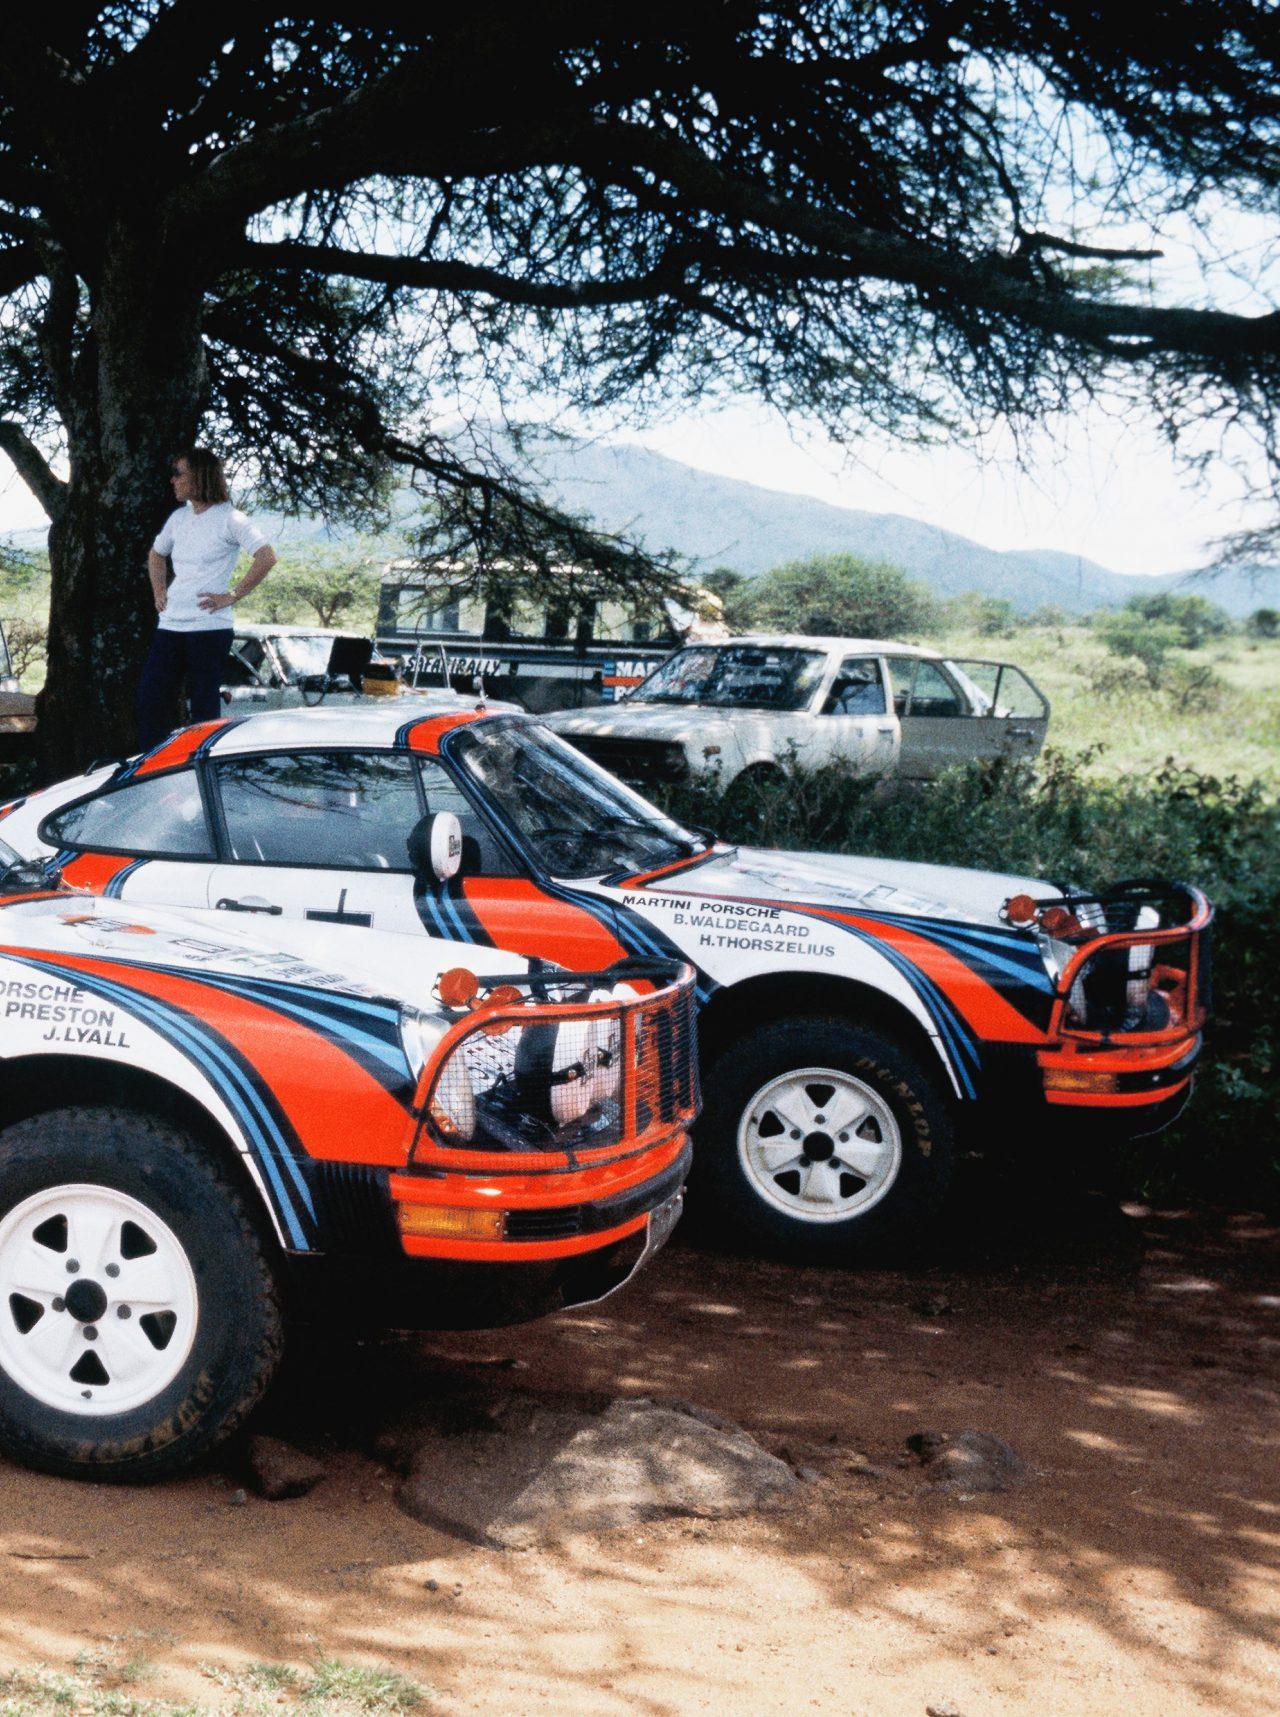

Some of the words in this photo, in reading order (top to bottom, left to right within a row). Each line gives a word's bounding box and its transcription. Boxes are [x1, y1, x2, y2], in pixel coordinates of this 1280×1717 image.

[622, 895, 691, 911] MARTINI
[700, 902, 781, 919] PORSCHE
[699, 934, 836, 957] H.THORSZELIUS
